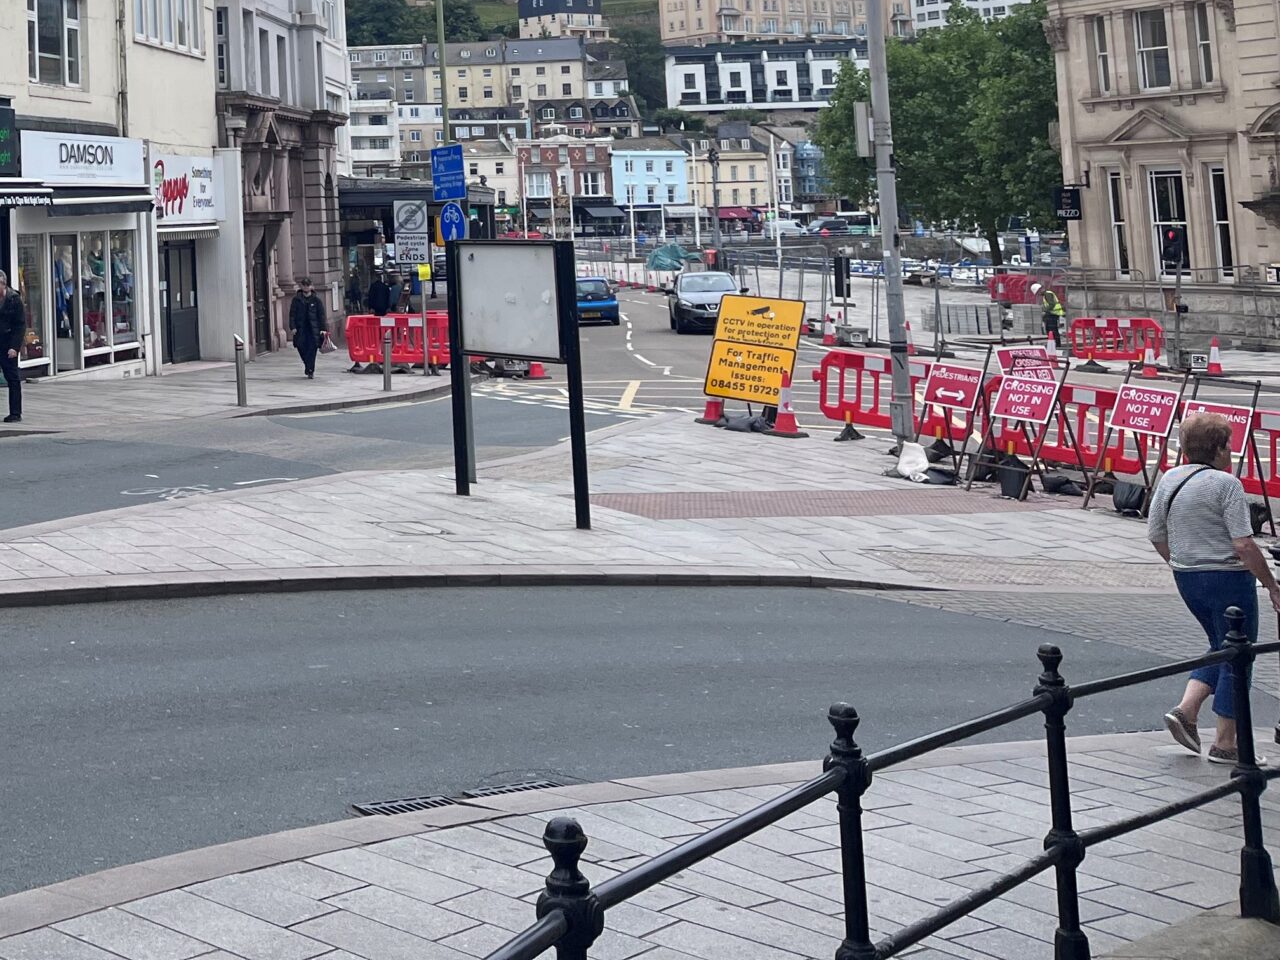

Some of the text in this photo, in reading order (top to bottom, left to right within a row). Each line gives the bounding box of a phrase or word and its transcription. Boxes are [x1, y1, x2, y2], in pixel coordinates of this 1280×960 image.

[59, 142, 114, 165] DAMSON
[399, 253, 425, 261] ENDS
[722, 317, 746, 326] CCTV
[756, 322, 796, 331] operation
[724, 326, 736, 334] for
[737, 329, 780, 339] protection
[726, 348, 780, 363] For Traffic
[718, 357, 784, 375] Management
[931, 370, 979, 384] PEDESTRIANS
[710, 378, 780, 396] 08455 19729
[1004, 381, 1054, 395] CROSSING
[1007, 393, 1042, 405] NOT IN
[1121, 390, 1174, 406] CROSSING
[1011, 405, 1031, 415] USE
[1125, 403, 1162, 417] NOT IN
[1129, 416, 1151, 427] USE
